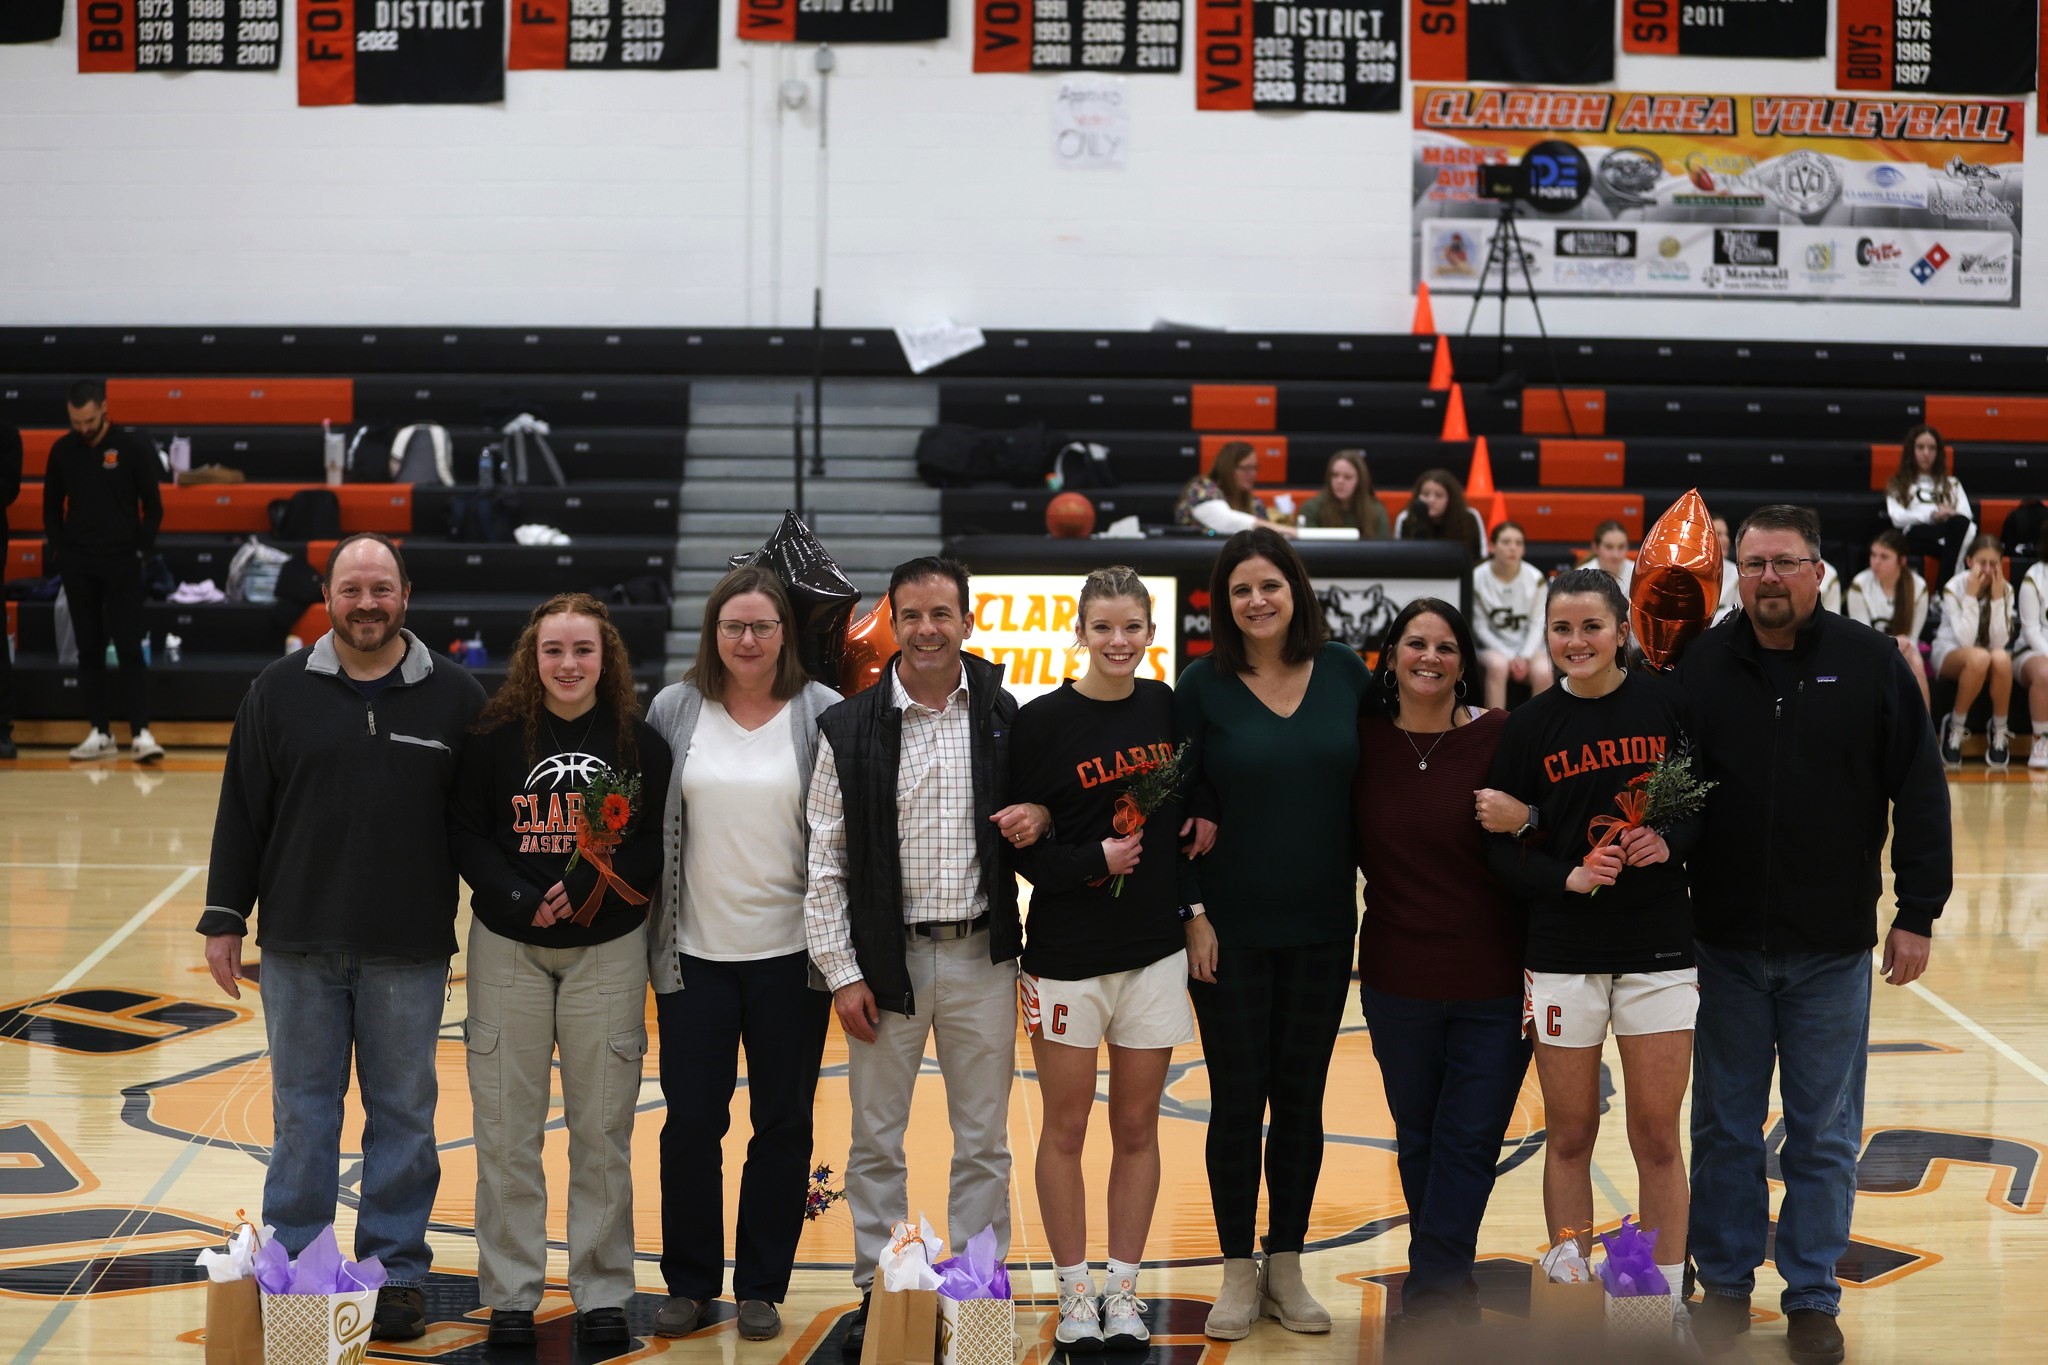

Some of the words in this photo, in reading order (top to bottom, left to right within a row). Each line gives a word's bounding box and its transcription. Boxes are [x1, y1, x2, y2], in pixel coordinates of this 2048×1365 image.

[137, 0, 174, 18] 1973
[375, 1, 484, 29] DISTRICT
[1682, 5, 1725, 27] 2011
[1895, 0, 1932, 18] 1974
[137, 21, 174, 41] 1978
[187, 21, 225, 41] 1989
[237, 21, 279, 41] 2000
[1274, 6, 1384, 39] DISTRICT
[1895, 20, 1932, 40] 1976
[356, 30, 399, 52] 2022
[621, 41, 664, 62] 2017
[1254, 37, 1294, 59] 2012
[1848, 23, 1883, 80] BOYS
[1895, 41, 1932, 63] 1986
[137, 44, 174, 65] 1979
[187, 43, 224, 64] 1996
[237, 43, 276, 65] 2001
[1895, 64, 1932, 85] 1987
[1302, 83, 1346, 106] 2021
[1423, 89, 1614, 133] CLARION
[1616, 94, 1738, 137] AREA
[1752, 96, 2014, 143] VOLLEYBALL
[1436, 168, 1487, 189] AUT
[1543, 735, 1667, 783] CLARION
[1052, 1003, 1068, 1035] C
[1547, 1005, 1561, 1037] C
